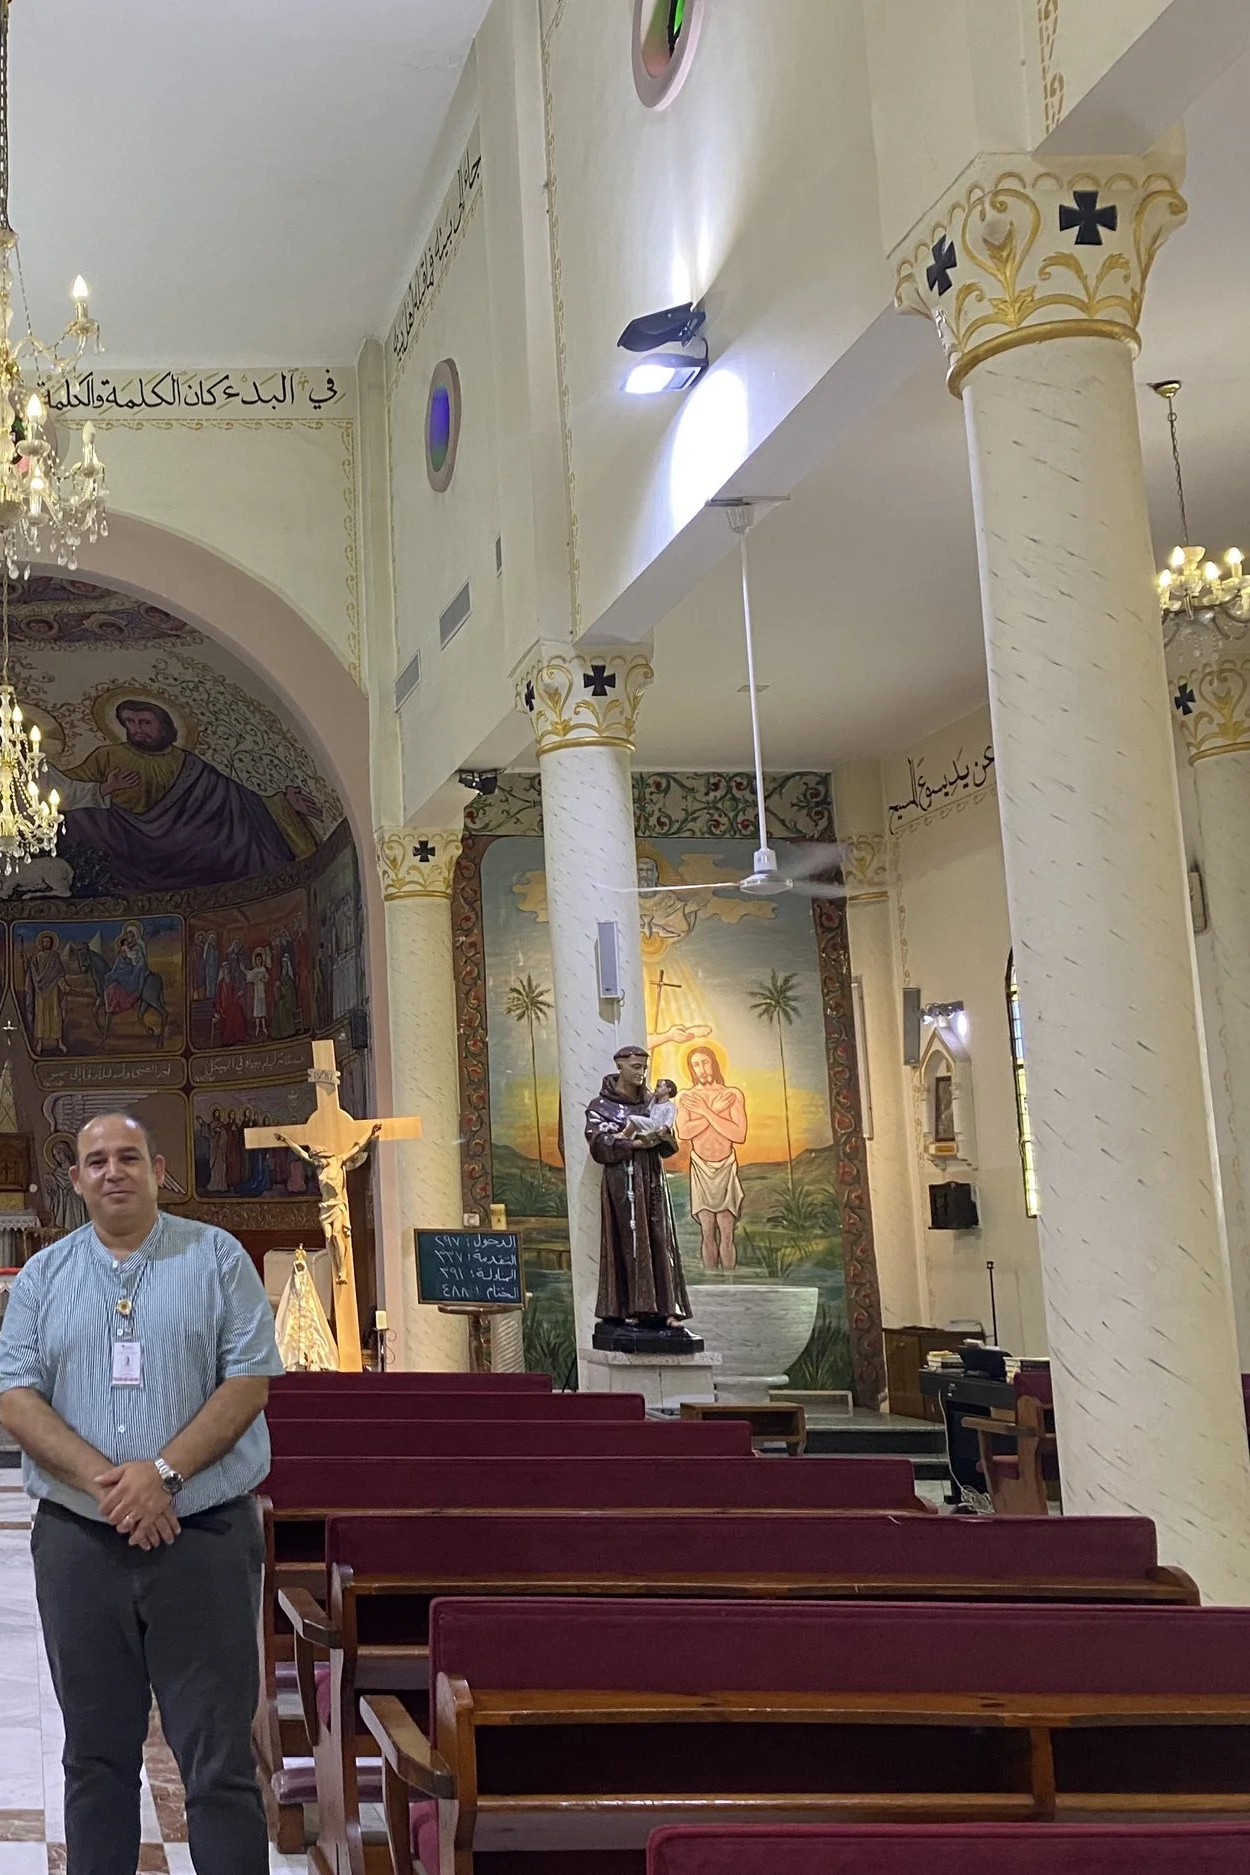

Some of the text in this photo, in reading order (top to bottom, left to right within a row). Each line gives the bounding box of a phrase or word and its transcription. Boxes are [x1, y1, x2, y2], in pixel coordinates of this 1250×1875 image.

[37, 371, 104, 410] والكلمة
[101, 371, 181, 409] الكلمة
[184, 374, 229, 407] كان
[223, 371, 295, 410] البدء
[309, 368, 338, 410] في
[888, 745, 994, 836] عن يد يسوع المسيح
